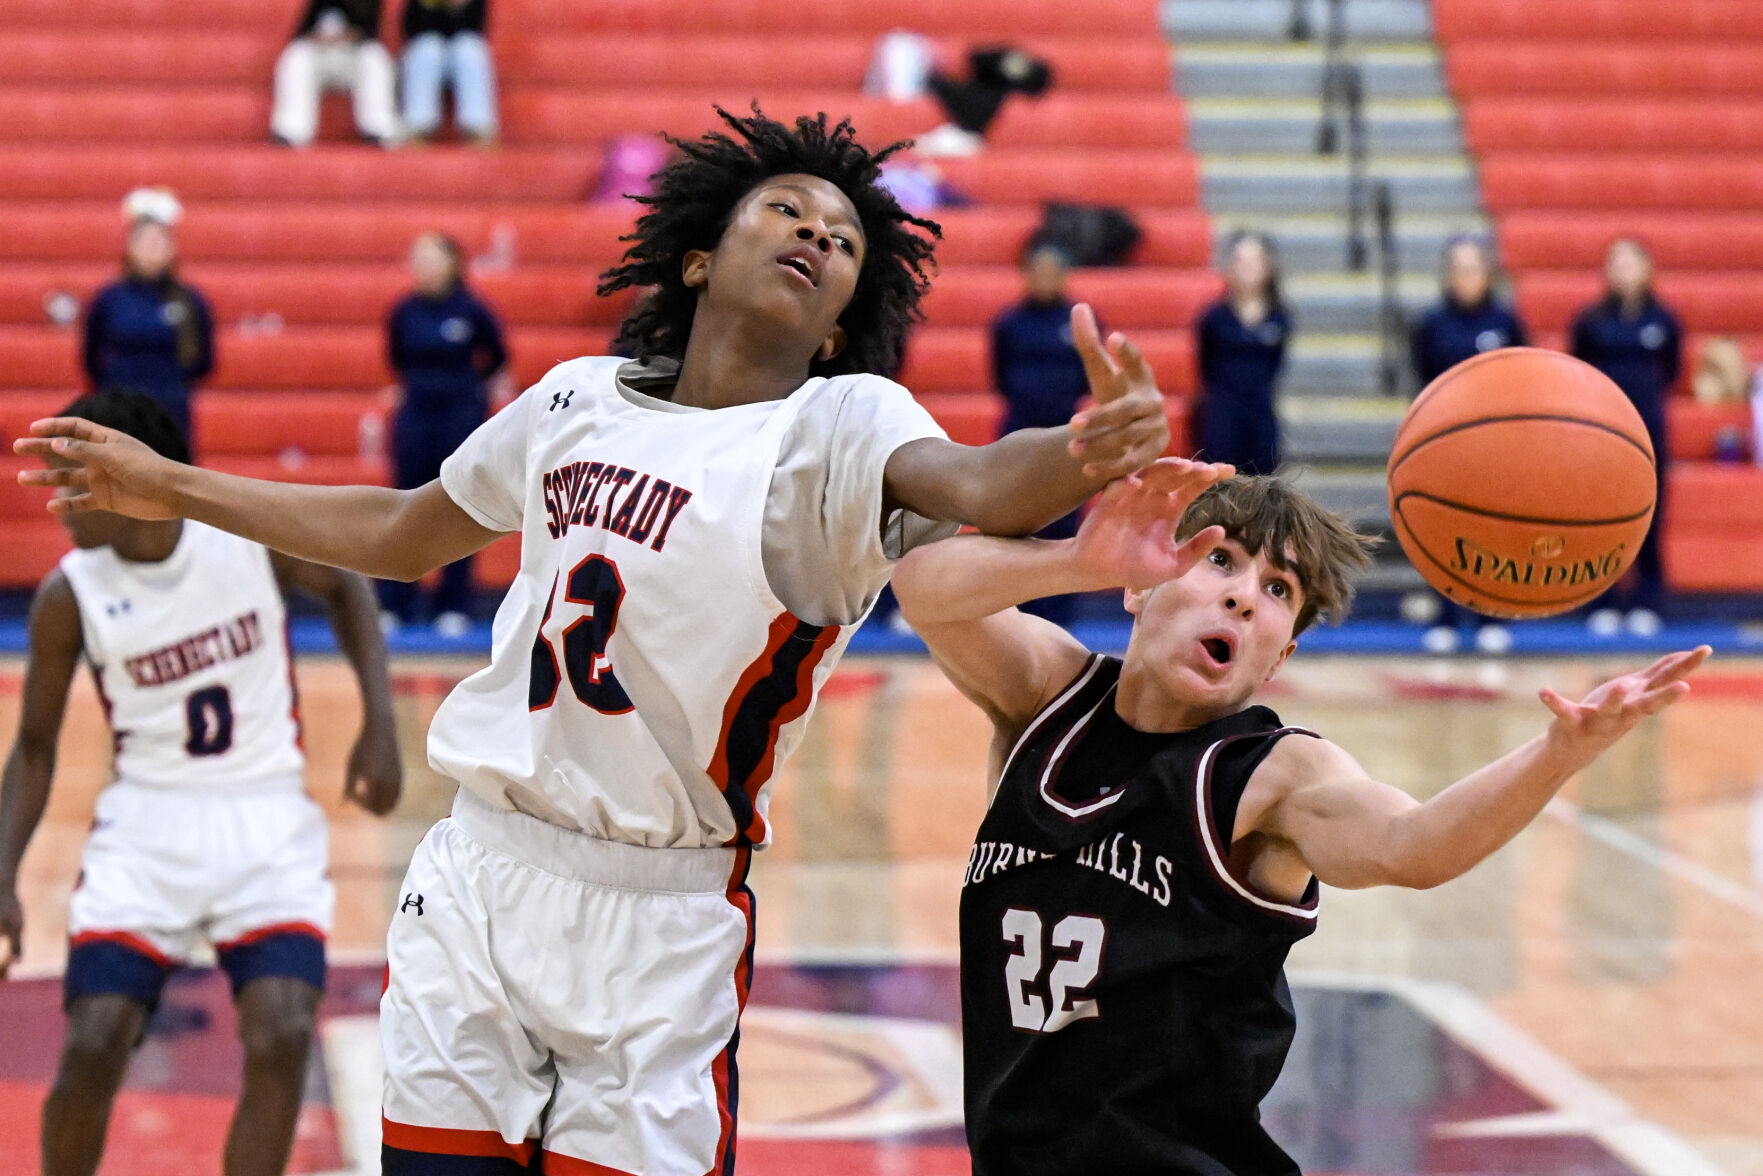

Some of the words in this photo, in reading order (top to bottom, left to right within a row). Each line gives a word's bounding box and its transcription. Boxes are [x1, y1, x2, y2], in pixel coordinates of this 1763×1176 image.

[1451, 537, 1626, 586] SPALDING
[184, 683, 234, 758] 0
[1001, 907, 1106, 1033] 22
